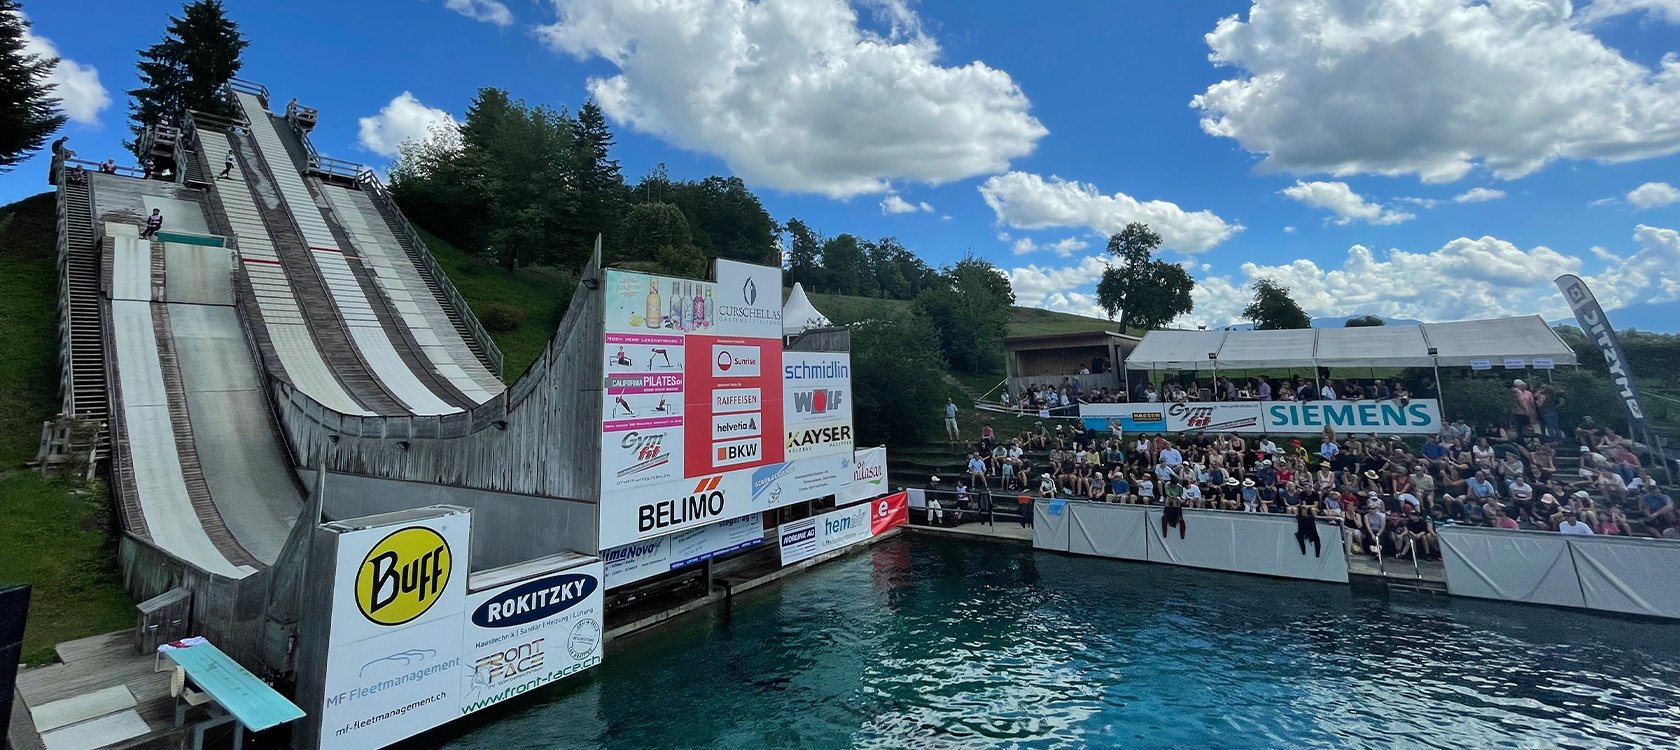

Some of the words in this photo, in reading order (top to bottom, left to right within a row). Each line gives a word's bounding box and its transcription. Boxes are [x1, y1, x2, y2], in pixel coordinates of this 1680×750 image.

[719, 305, 782, 320] CURSCHELLAS
[734, 357, 757, 365] Sunrise
[785, 360, 848, 379] schmidlin
[717, 395, 757, 405] RAIFFEISEN
[794, 389, 842, 414] WOLF
[1168, 403, 1214, 422] Gym
[1187, 416, 1212, 427] fit
[1269, 403, 1432, 427] SIEMENS
[717, 421, 748, 432] helvetia
[621, 432, 664, 455] Gym
[786, 425, 852, 449] KAYSER
[637, 446, 661, 460] fit
[728, 443, 757, 460] BKW
[639, 491, 724, 532] BELIMO
[487, 579, 586, 623] ROKITZKY
[475, 632, 515, 648] Haustechnk
[326, 692, 347, 709] MF
[349, 657, 460, 701] Fleetmanagement
[462, 654, 602, 715] www.front-face.ch
[335, 691, 446, 737] mf-fleetmanagement.ch
